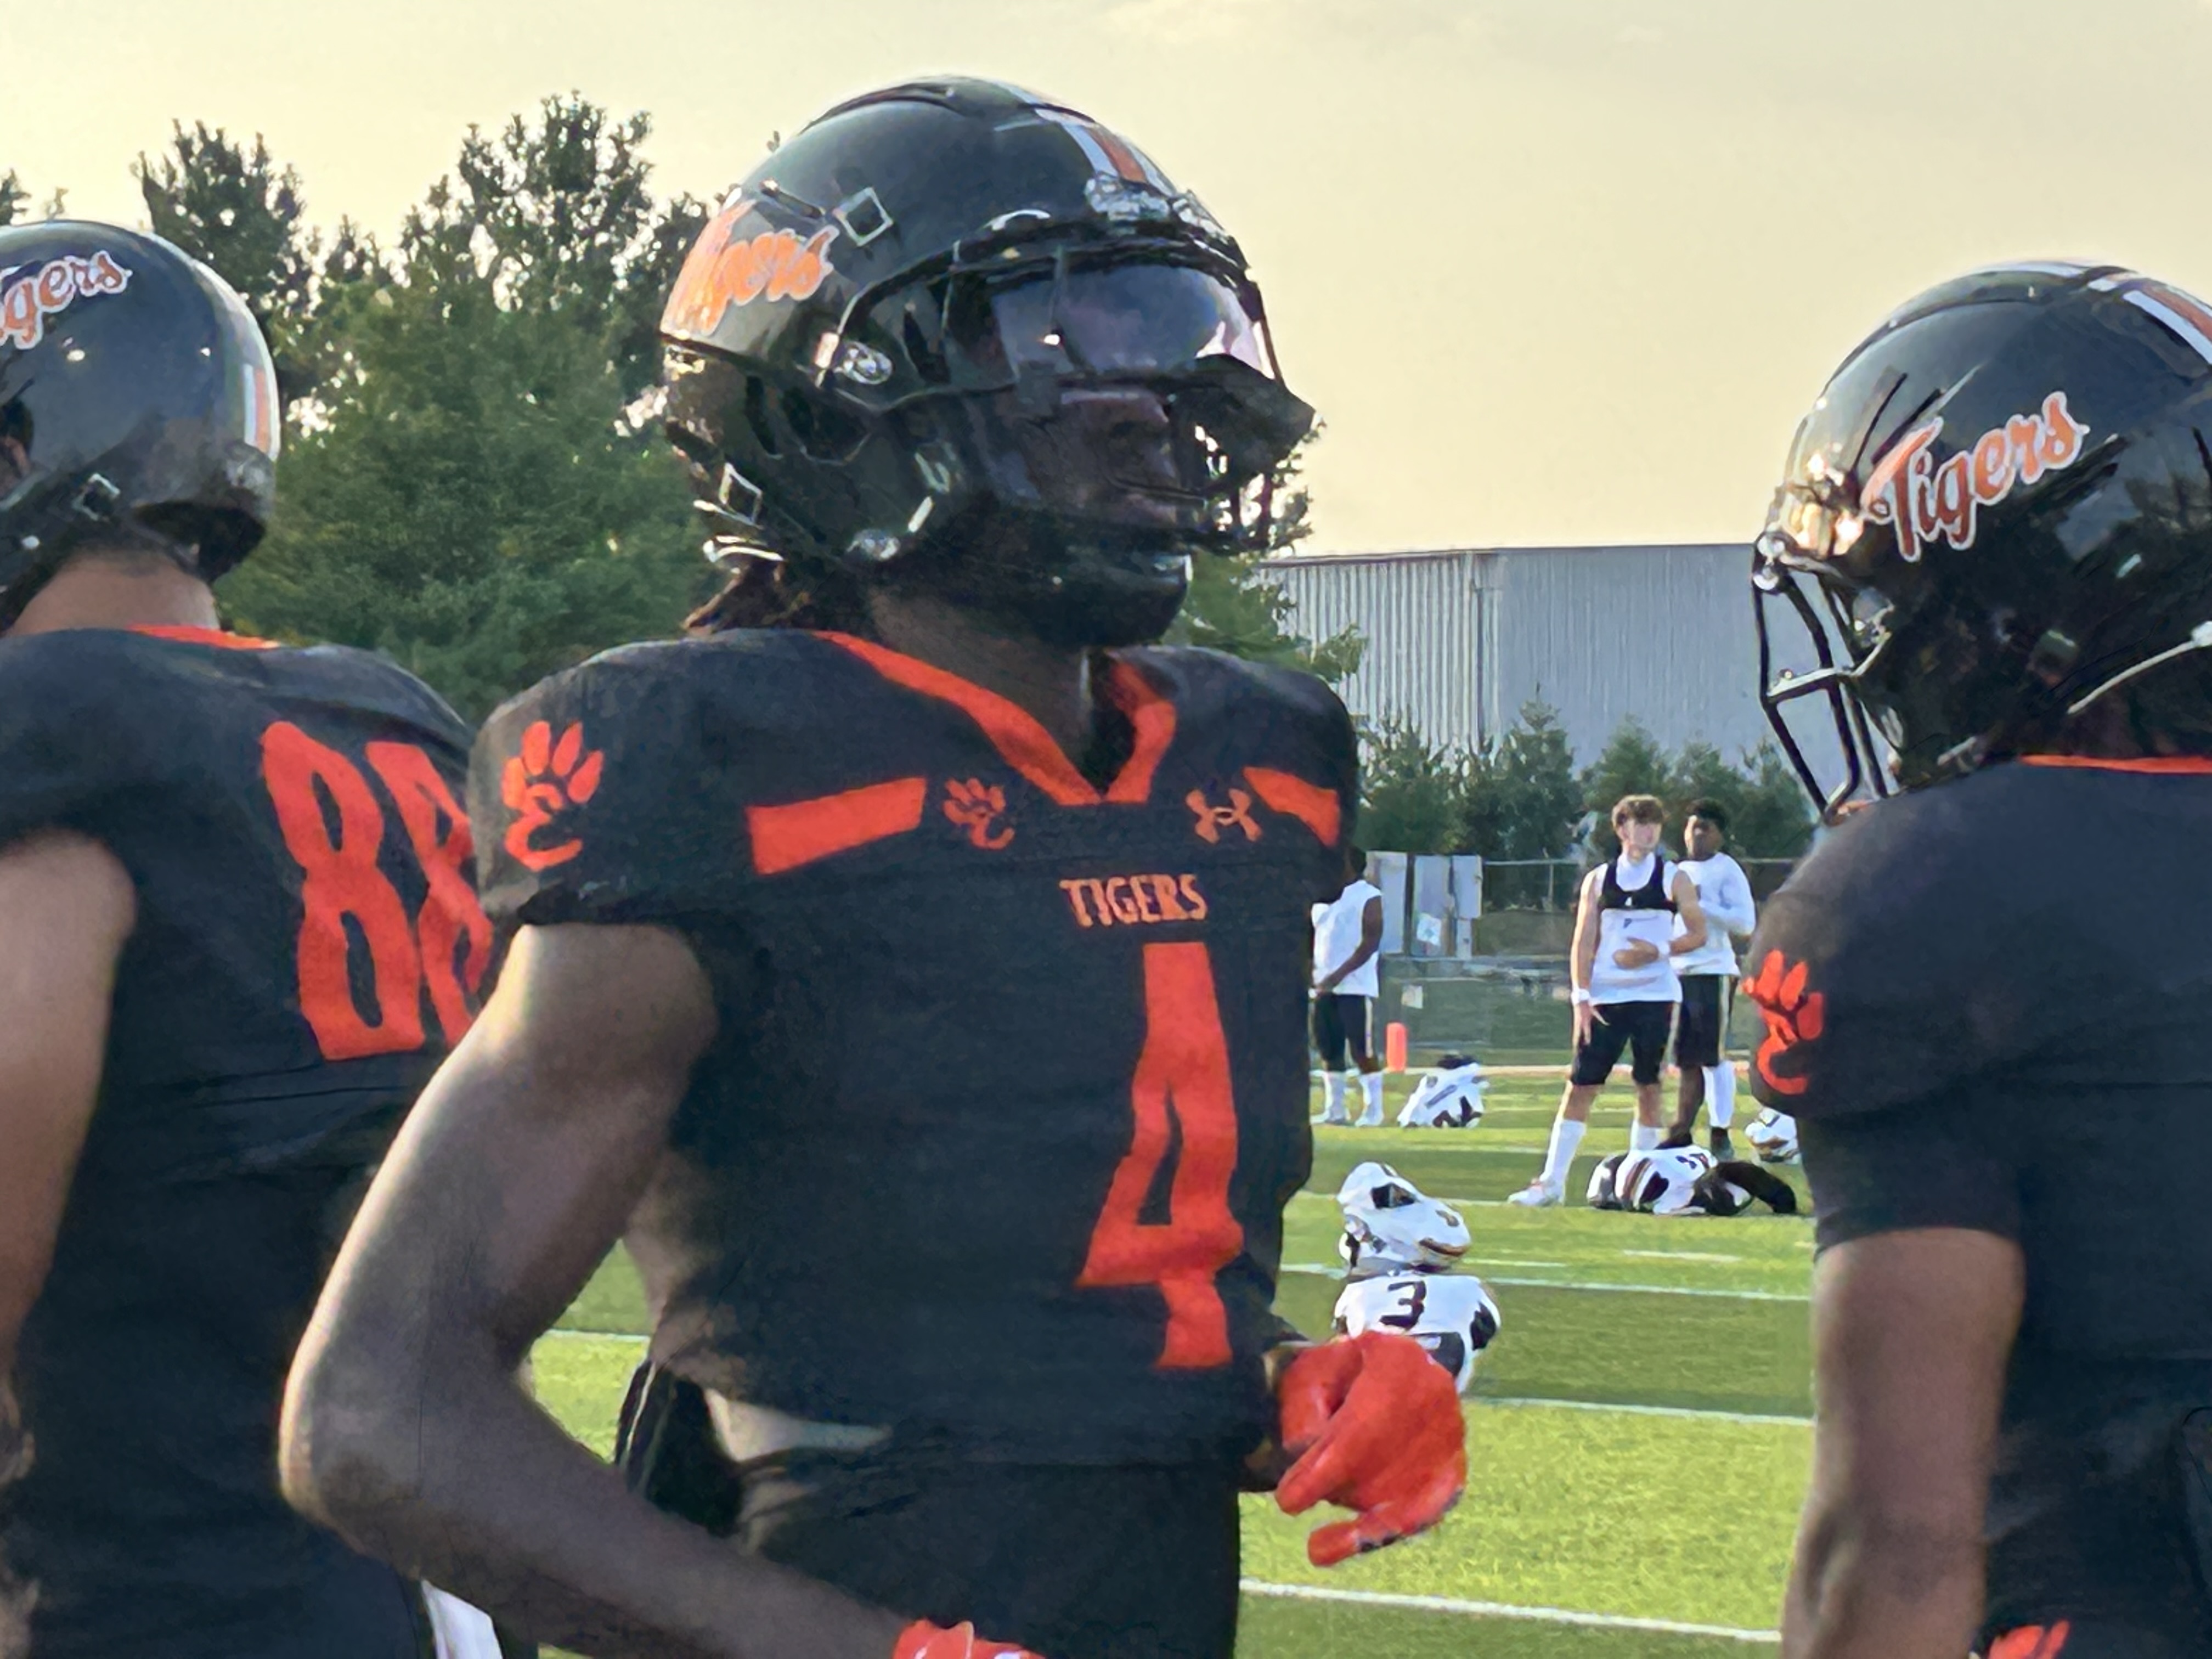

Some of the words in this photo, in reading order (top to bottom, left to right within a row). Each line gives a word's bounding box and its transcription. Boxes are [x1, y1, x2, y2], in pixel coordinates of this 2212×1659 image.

[1860, 391, 2090, 562] Tigers
[260, 721, 493, 1061] 88
[1059, 874, 1207, 927] TIGERS
[1073, 941, 1245, 1368] 4
[1379, 1280, 1426, 1330] 3
